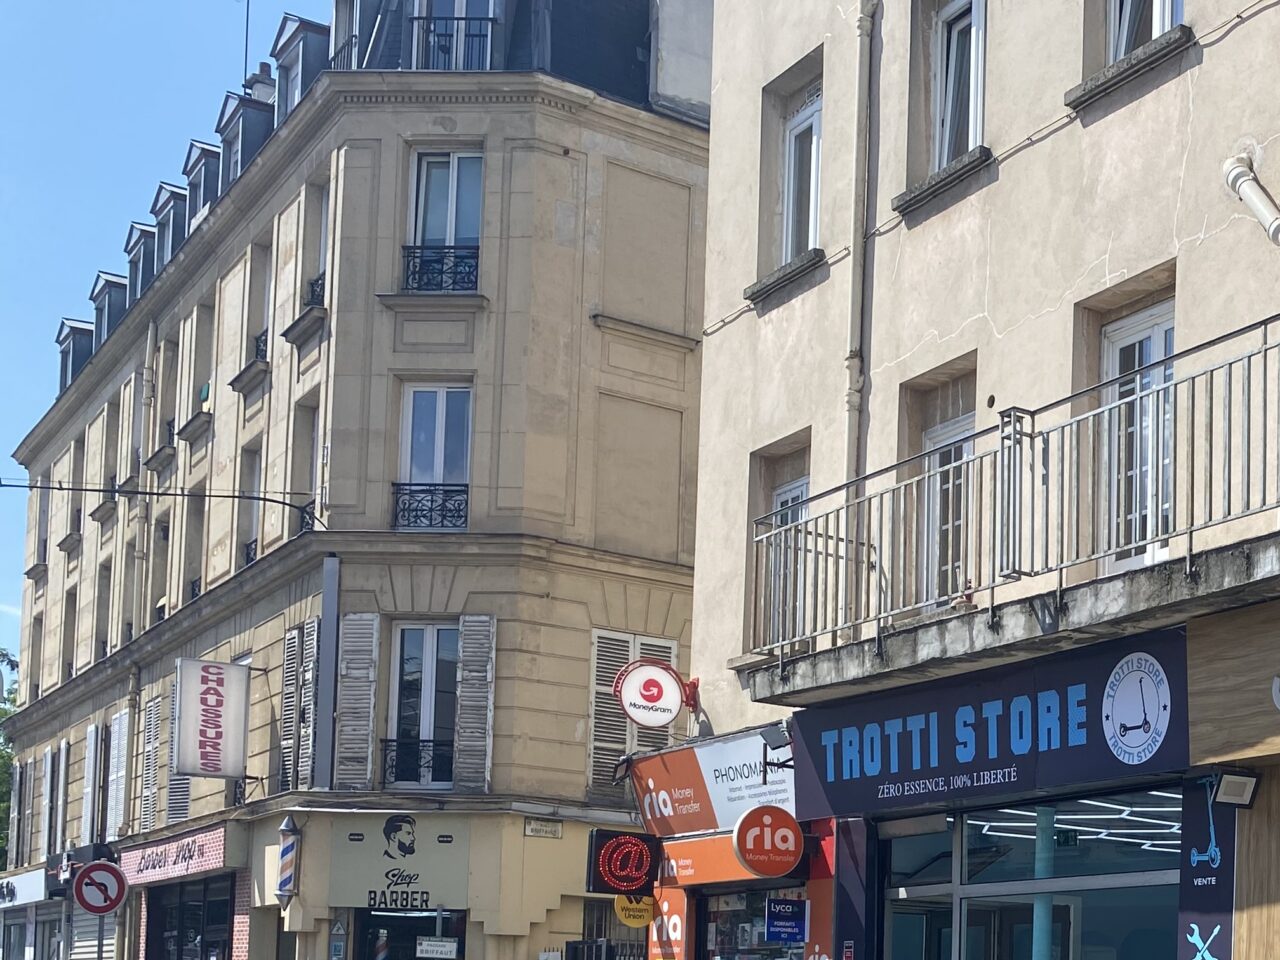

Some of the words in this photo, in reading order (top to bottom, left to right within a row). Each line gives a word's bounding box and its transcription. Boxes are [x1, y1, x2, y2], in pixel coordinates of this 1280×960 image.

[1107, 658, 1134, 700] TROTTI
[1136, 657, 1165, 689] STORE
[629, 701, 672, 714] MoneyGram
[200, 665, 224, 773] CHAUSSURES
[821, 711, 939, 782] TROTTI
[955, 683, 1087, 763] STORE
[1109, 731, 1134, 763] TROTTI
[1137, 727, 1163, 762] STORE
[878, 781, 902, 798] ZÉRO
[904, 777, 948, 796] ESSENCE,
[950, 773, 971, 790] 100%
[973, 763, 1018, 787] LIBERTÉ
[644, 777, 674, 820] ria
[672, 787, 694, 800] Money
[674, 800, 700, 814] Transfer
[746, 814, 795, 850] ria
[745, 853, 768, 862] Money
[769, 853, 795, 862] Transfer
[384, 867, 420, 890] Shop
[1193, 877, 1216, 886] VENTE
[368, 889, 430, 909] BARBER
[620, 905, 649, 914] Western
[771, 902, 792, 913] Lyca
[625, 911, 645, 920] Union
[652, 900, 682, 942] ria
